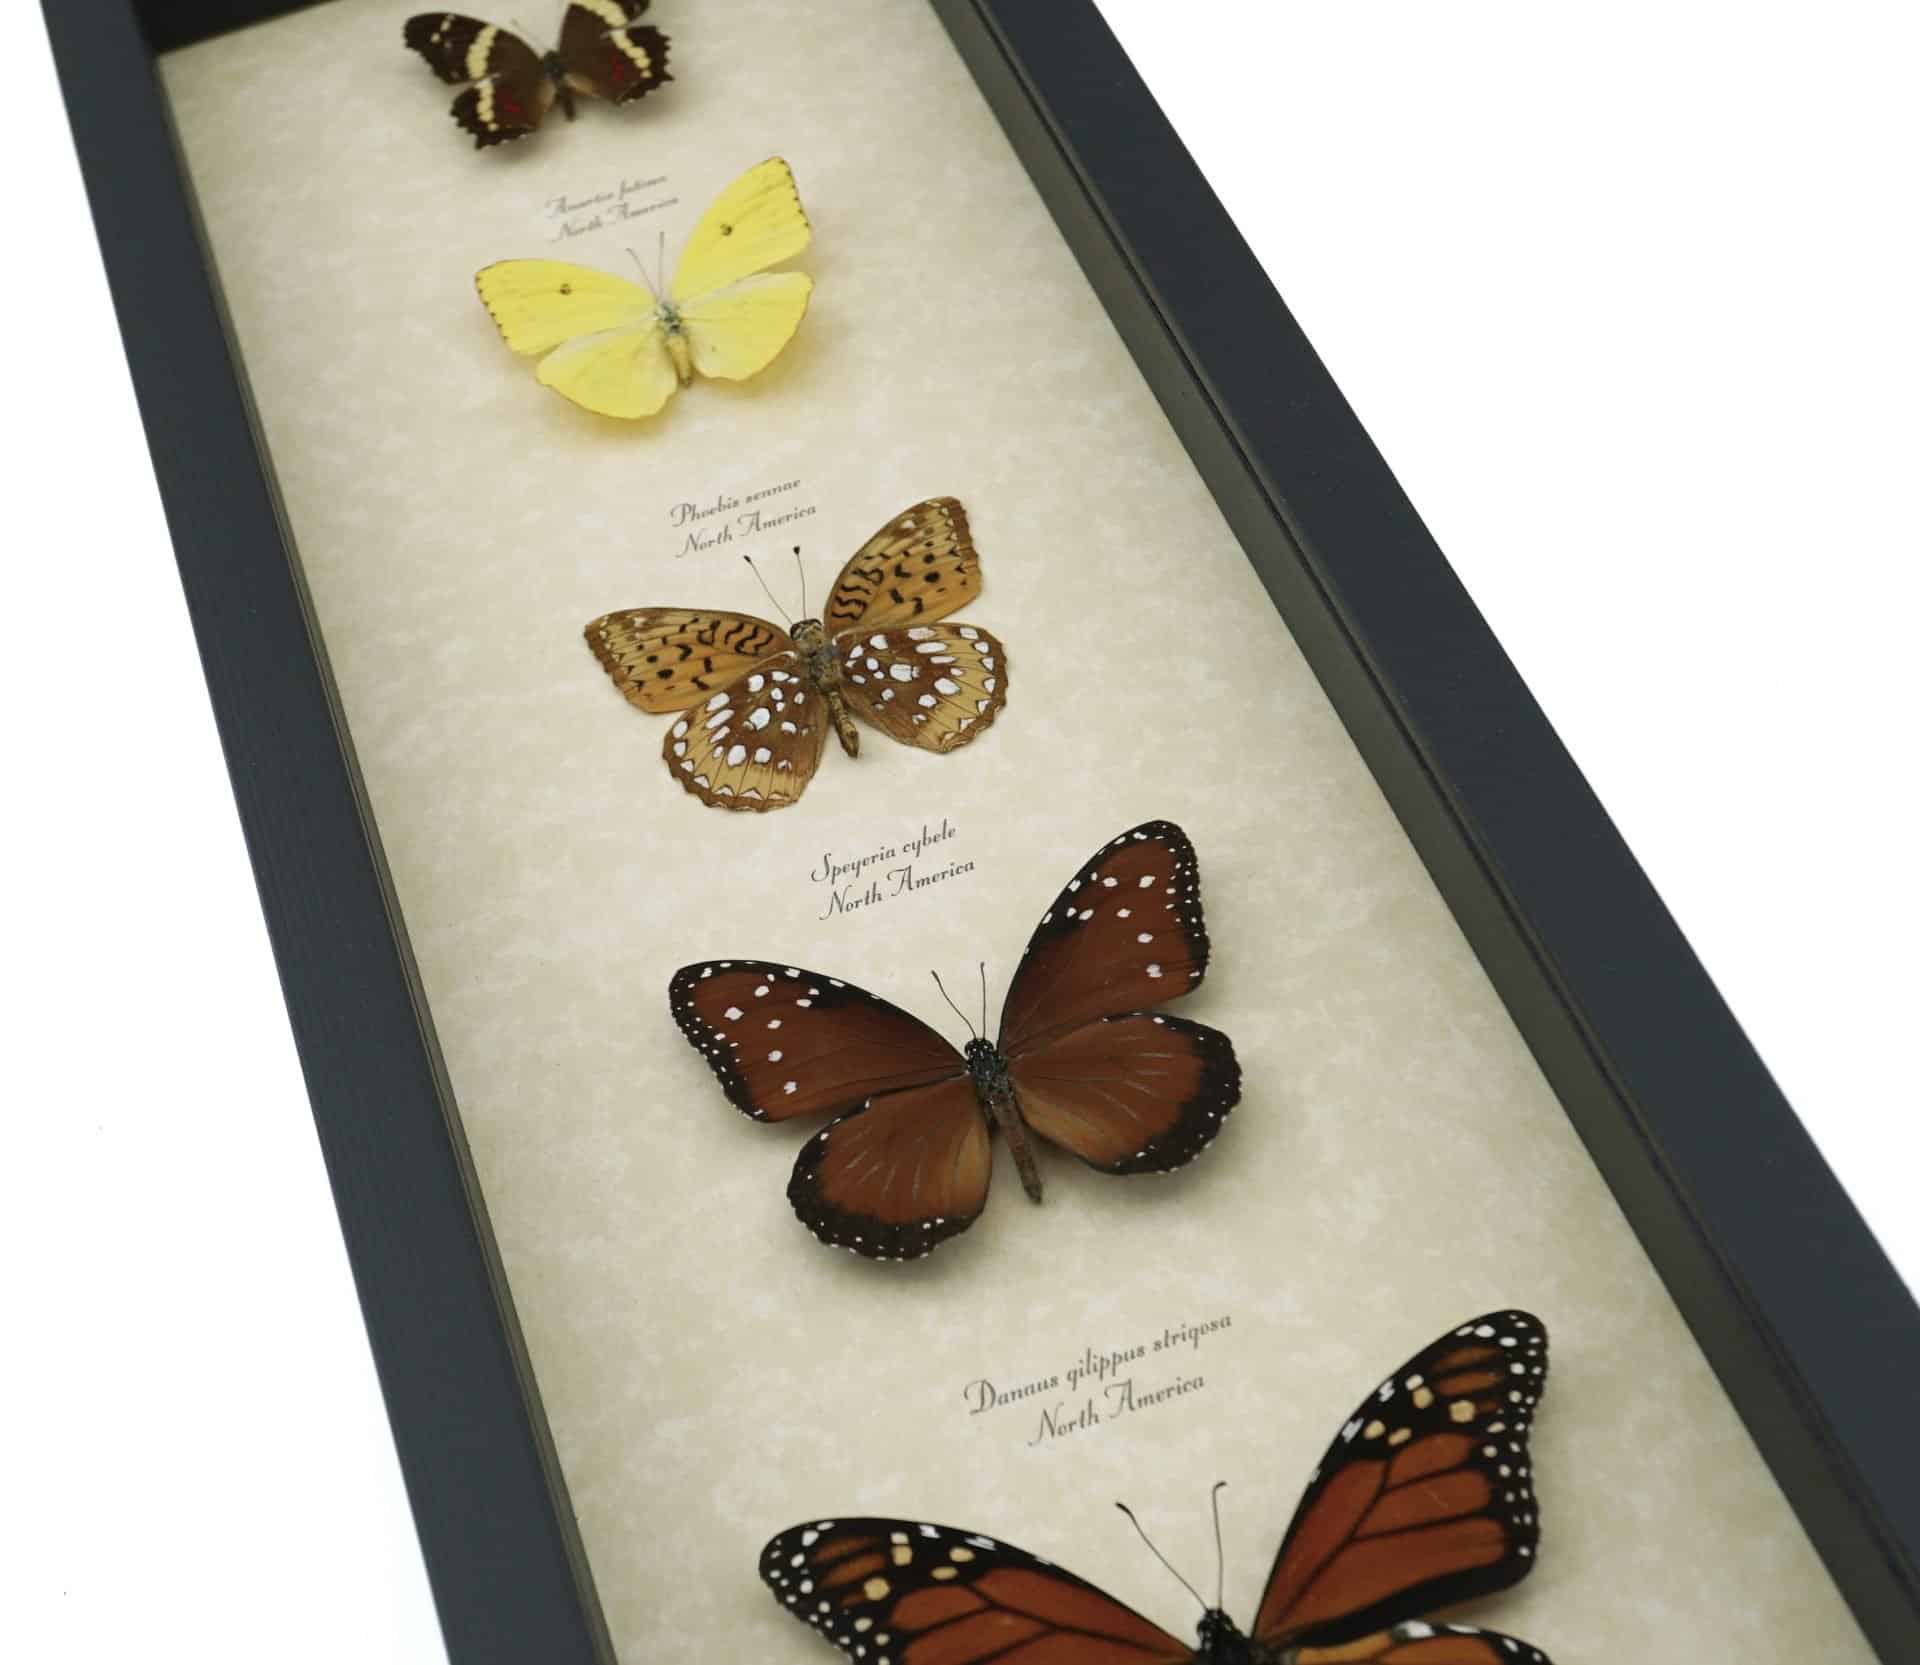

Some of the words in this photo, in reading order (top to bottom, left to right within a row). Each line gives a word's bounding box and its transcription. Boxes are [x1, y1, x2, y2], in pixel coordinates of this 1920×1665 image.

[670, 495, 740, 528] Phoebis
[745, 479, 801, 504] sennae
[674, 525, 733, 558] North
[737, 505, 817, 536] America
[811, 846, 896, 885] Speyeria
[902, 818, 957, 858] cybele
[819, 881, 883, 920] North
[887, 860, 976, 896] America
[964, 1375, 1060, 1416] Danaus
[1027, 1398, 1100, 1447] North
[1104, 1375, 1205, 1418] America
